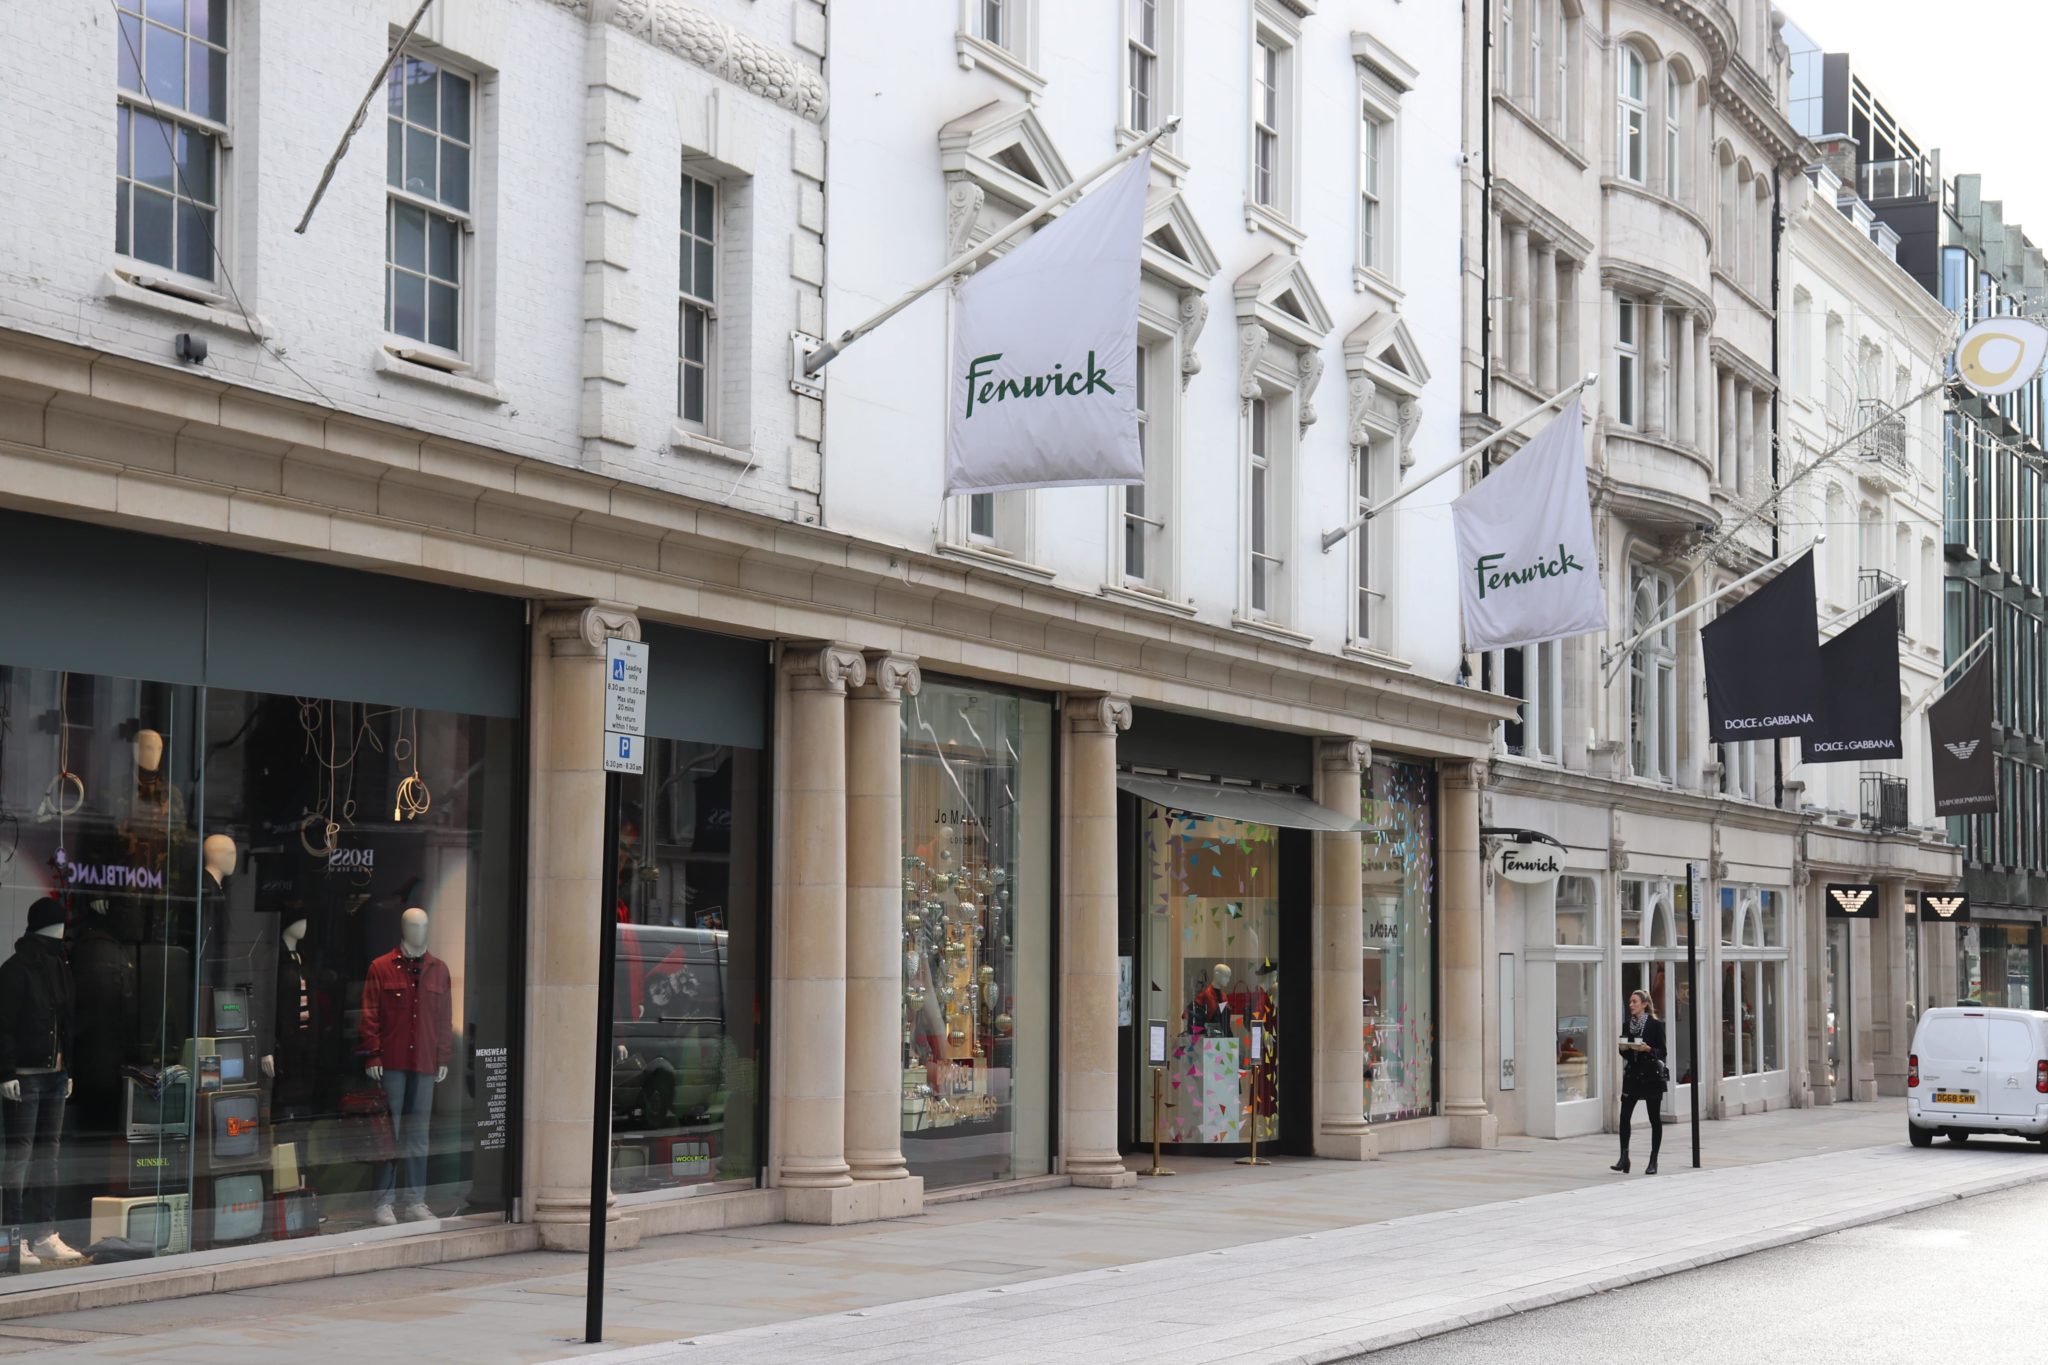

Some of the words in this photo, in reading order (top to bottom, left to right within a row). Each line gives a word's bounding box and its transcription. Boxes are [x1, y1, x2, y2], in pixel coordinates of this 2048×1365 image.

[965, 350, 1116, 419] Fenwick
[1473, 543, 1584, 600] Fenwick
[626, 664, 642, 674] Loading
[627, 697, 636, 705] stay
[616, 713, 622, 721] No
[1725, 718, 1757, 730] DOLCE
[1763, 713, 1814, 727] GABBANA
[612, 722, 625, 730] within
[622, 739, 629, 756] P
[1814, 742, 1843, 752] DOLCE
[1849, 739, 1895, 750] GABBANA
[1501, 851, 1559, 874] Fenwick
[475, 1048, 507, 1057] MENSWEAR
